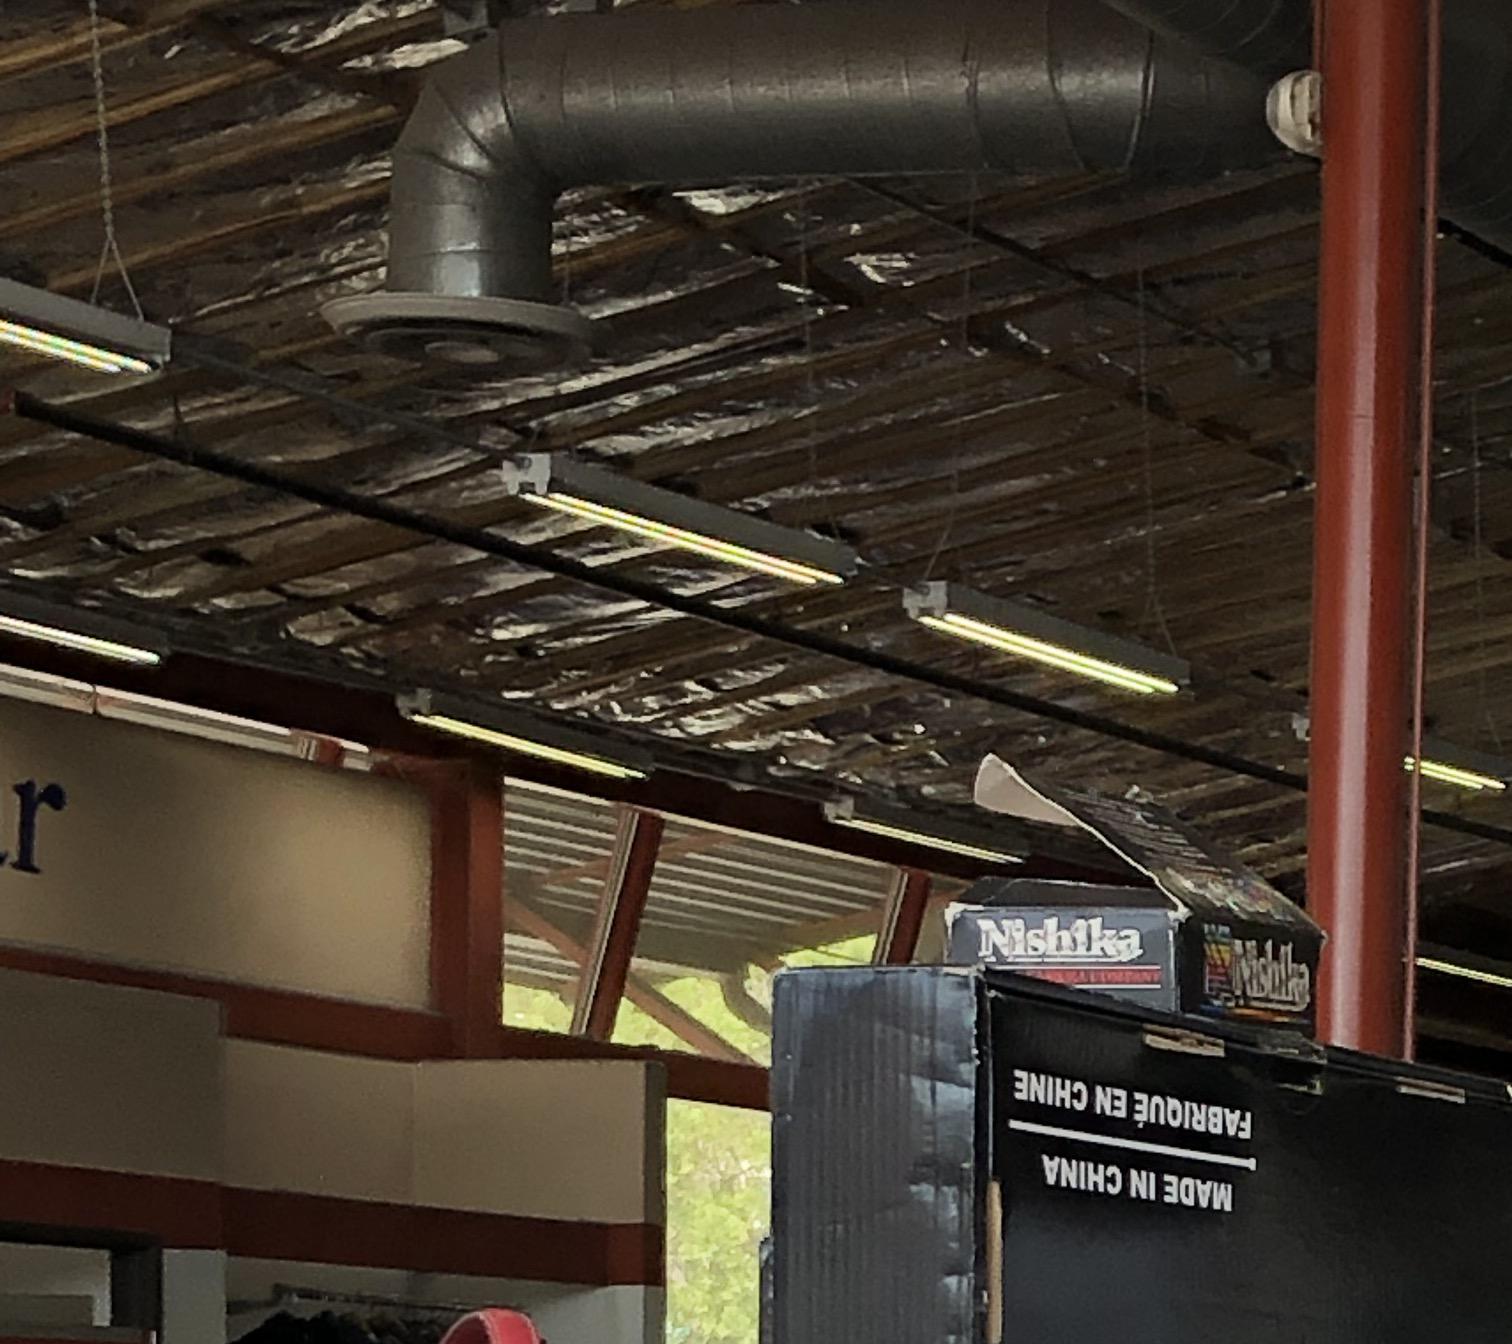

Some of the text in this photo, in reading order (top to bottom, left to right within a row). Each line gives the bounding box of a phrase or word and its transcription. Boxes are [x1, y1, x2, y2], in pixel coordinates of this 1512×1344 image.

[0, 778, 67, 874] r
[976, 915, 1144, 962] Nishika
[1233, 938, 1311, 1011] Nishika
[1013, 1069, 1251, 1139] FABRIQUÉ EN CHINE
[1041, 1153, 1232, 1212] MADE IN CHINA
